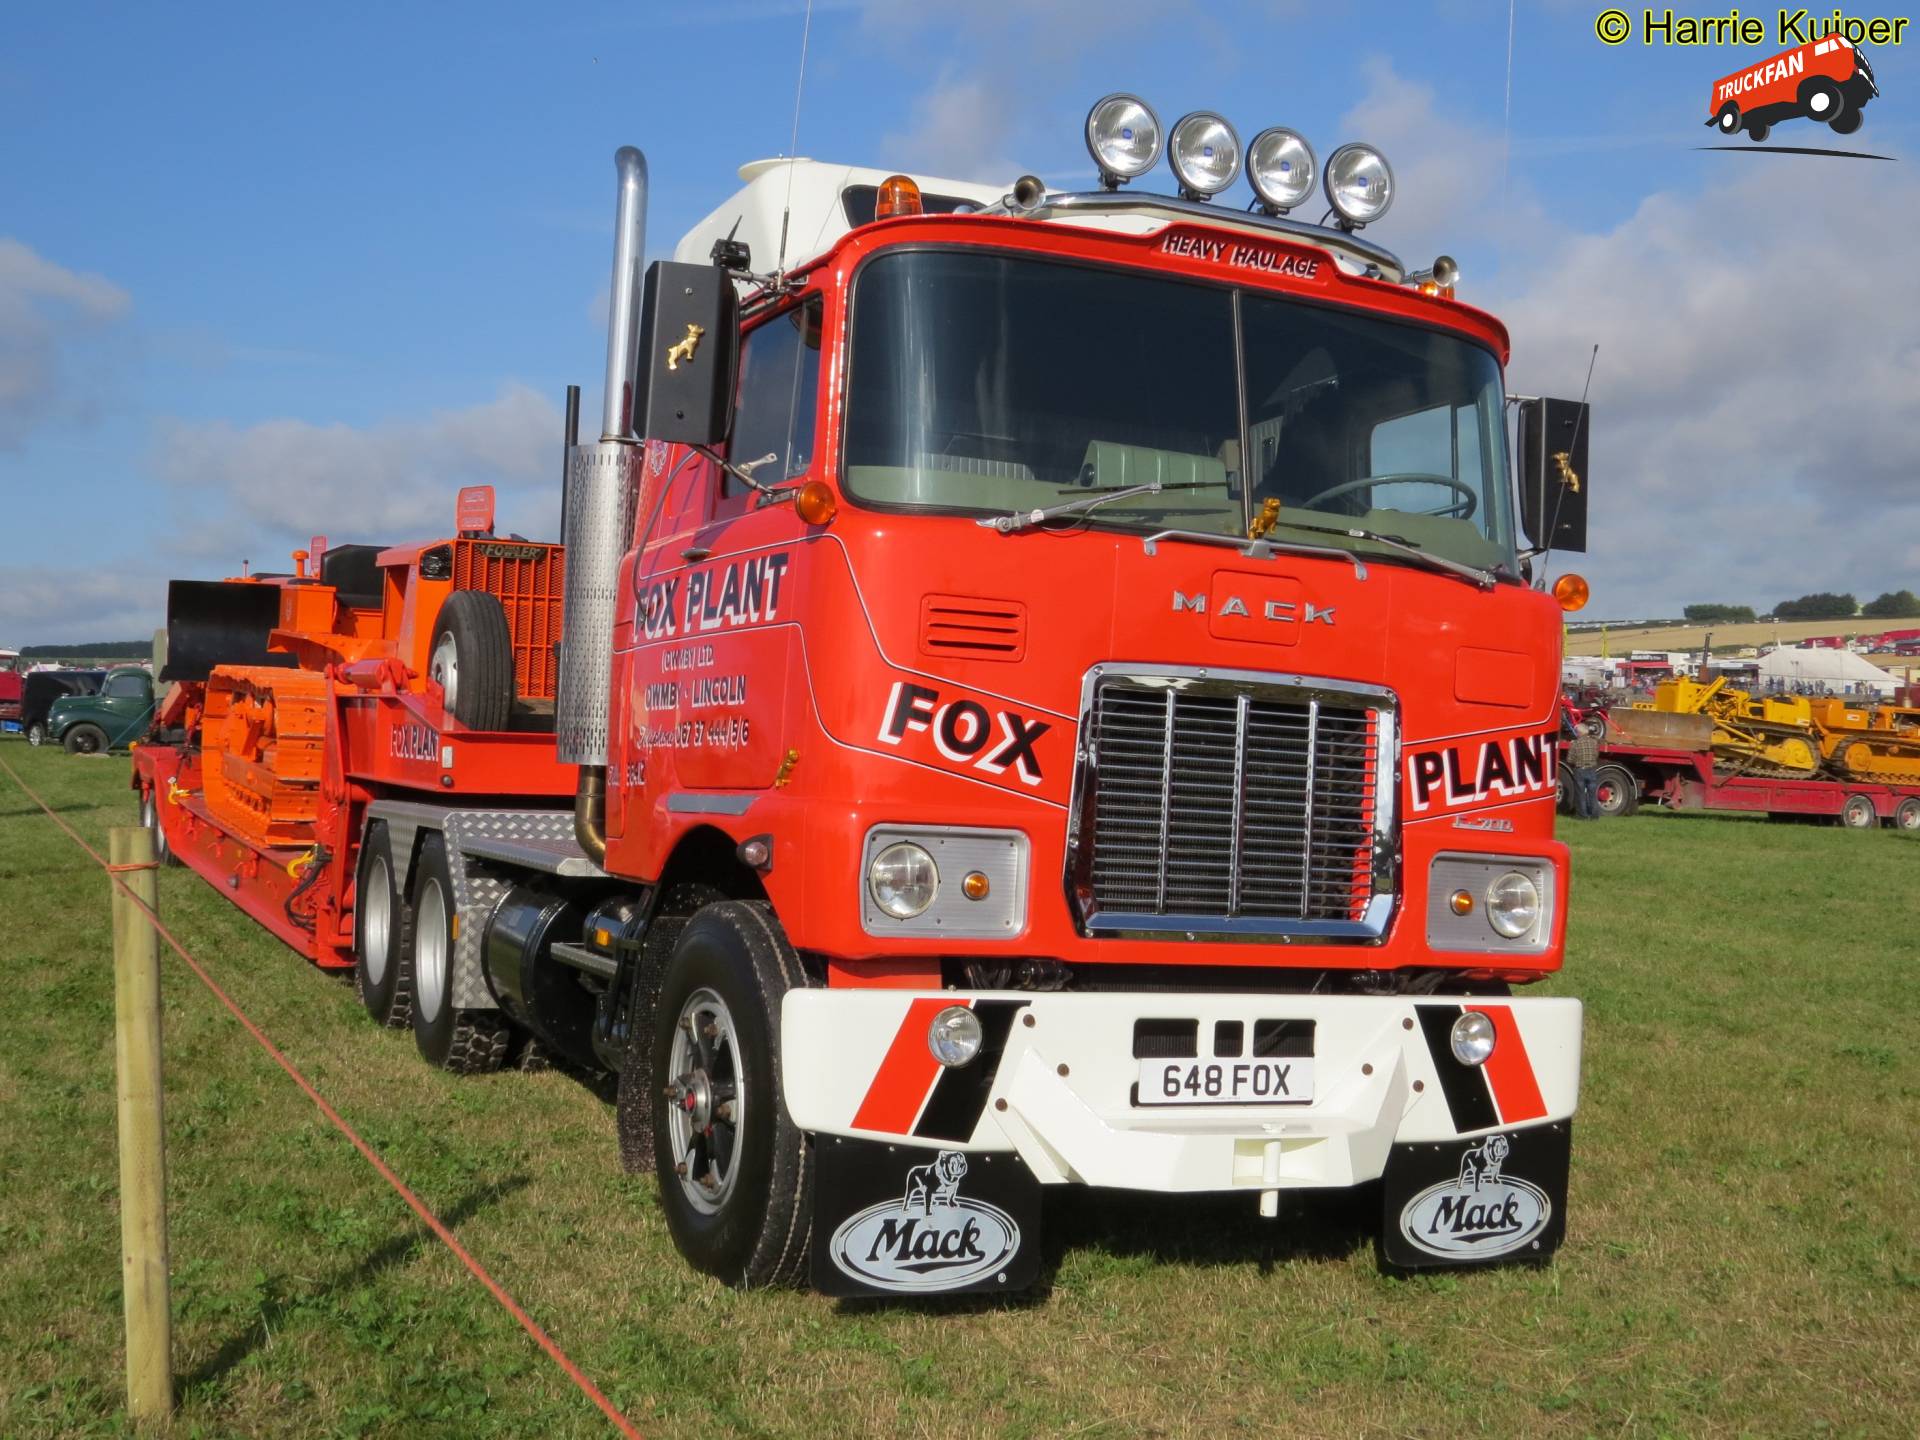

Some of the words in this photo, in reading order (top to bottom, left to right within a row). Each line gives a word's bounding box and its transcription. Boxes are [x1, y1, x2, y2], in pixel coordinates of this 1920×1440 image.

[1161, 236, 1226, 262] HEAVY
[1230, 246, 1319, 279] HAULAGE
[485, 543, 538, 558] FOWLER
[633, 578, 678, 642] FOX
[685, 554, 788, 632] PLANT
[1172, 590, 1336, 625] MACK
[692, 674, 746, 708] LINCOLN
[390, 724, 408, 758] FOX
[410, 725, 440, 762] PLANT
[877, 681, 1052, 786] FOX
[1408, 732, 1559, 812] PLANT
[1163, 1064, 1223, 1097] 648
[1232, 1064, 1291, 1096] FOX
[1427, 1192, 1523, 1237] Mack
[865, 1216, 986, 1265] Mack
